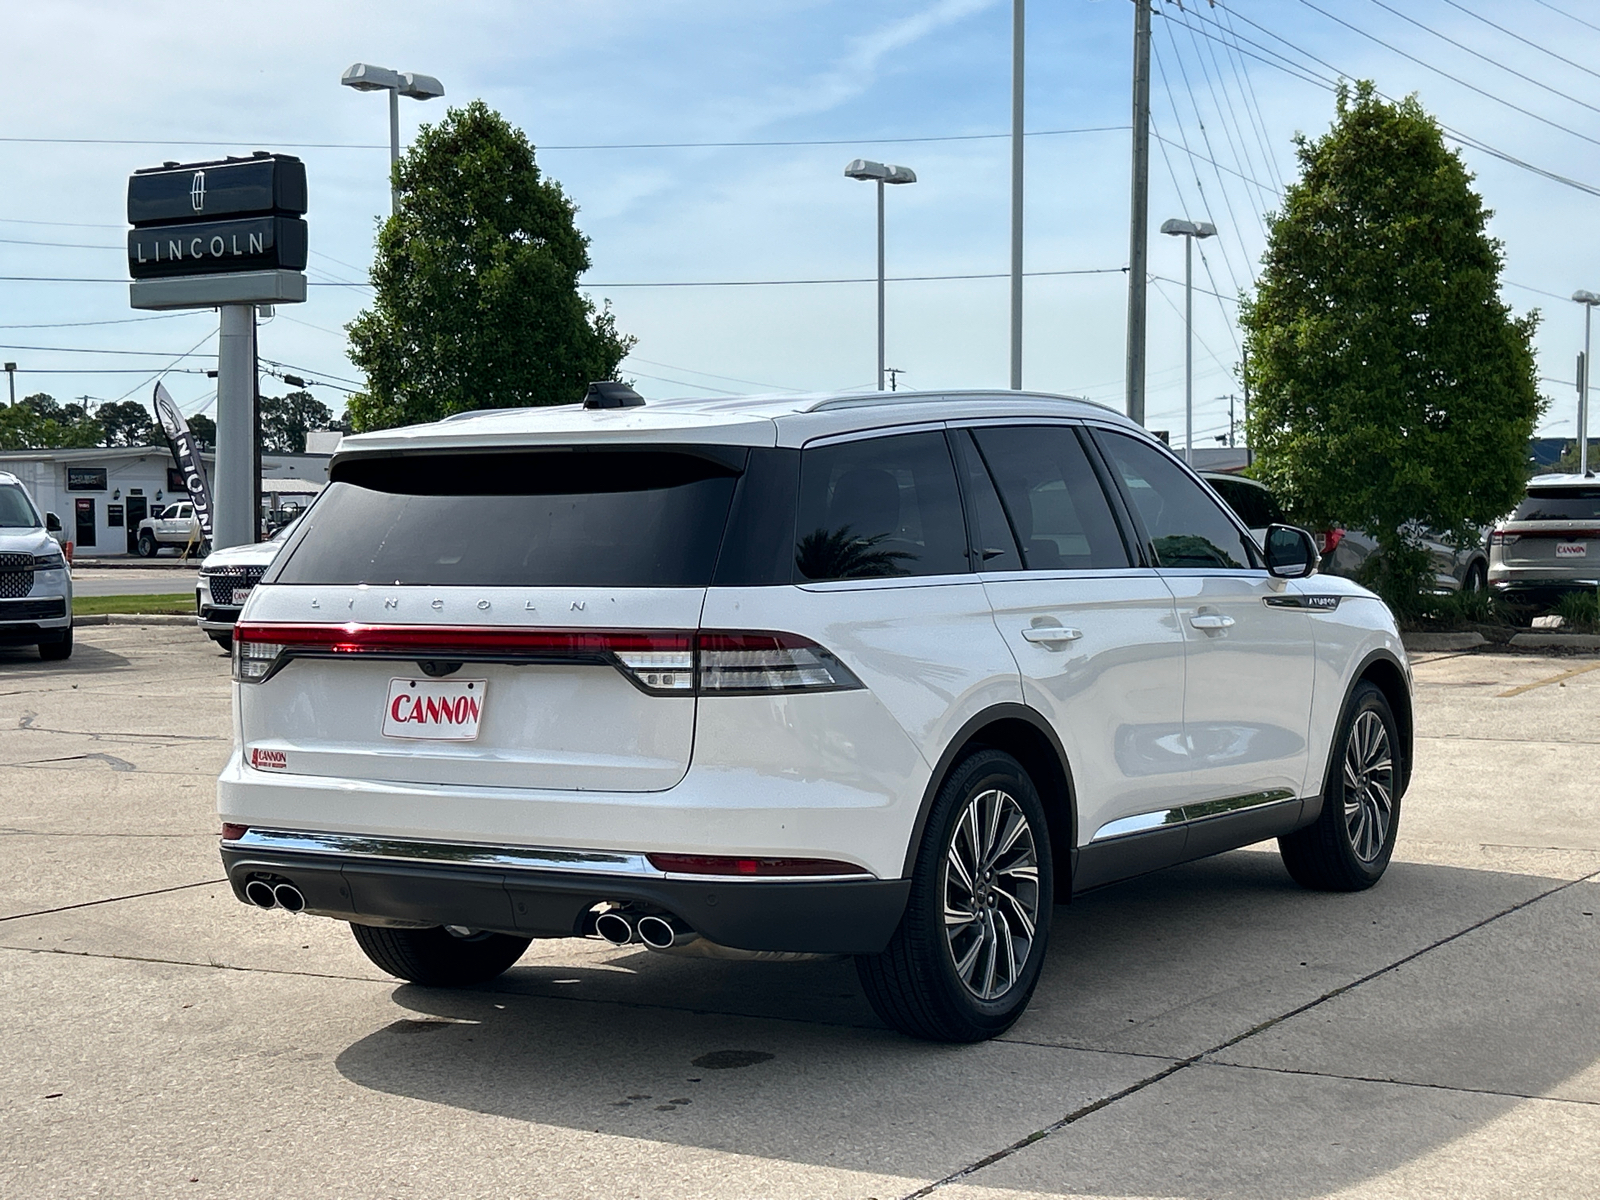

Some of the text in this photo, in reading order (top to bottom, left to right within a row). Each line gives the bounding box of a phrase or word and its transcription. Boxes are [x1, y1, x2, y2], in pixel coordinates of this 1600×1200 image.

[137, 232, 264, 264] LINCOLN
[177, 438, 213, 547] INCOLN
[1557, 545, 1585, 554] CANNON
[311, 597, 585, 612] LINCOLN
[391, 694, 481, 725] CANNON
[258, 749, 287, 763] CANNON
